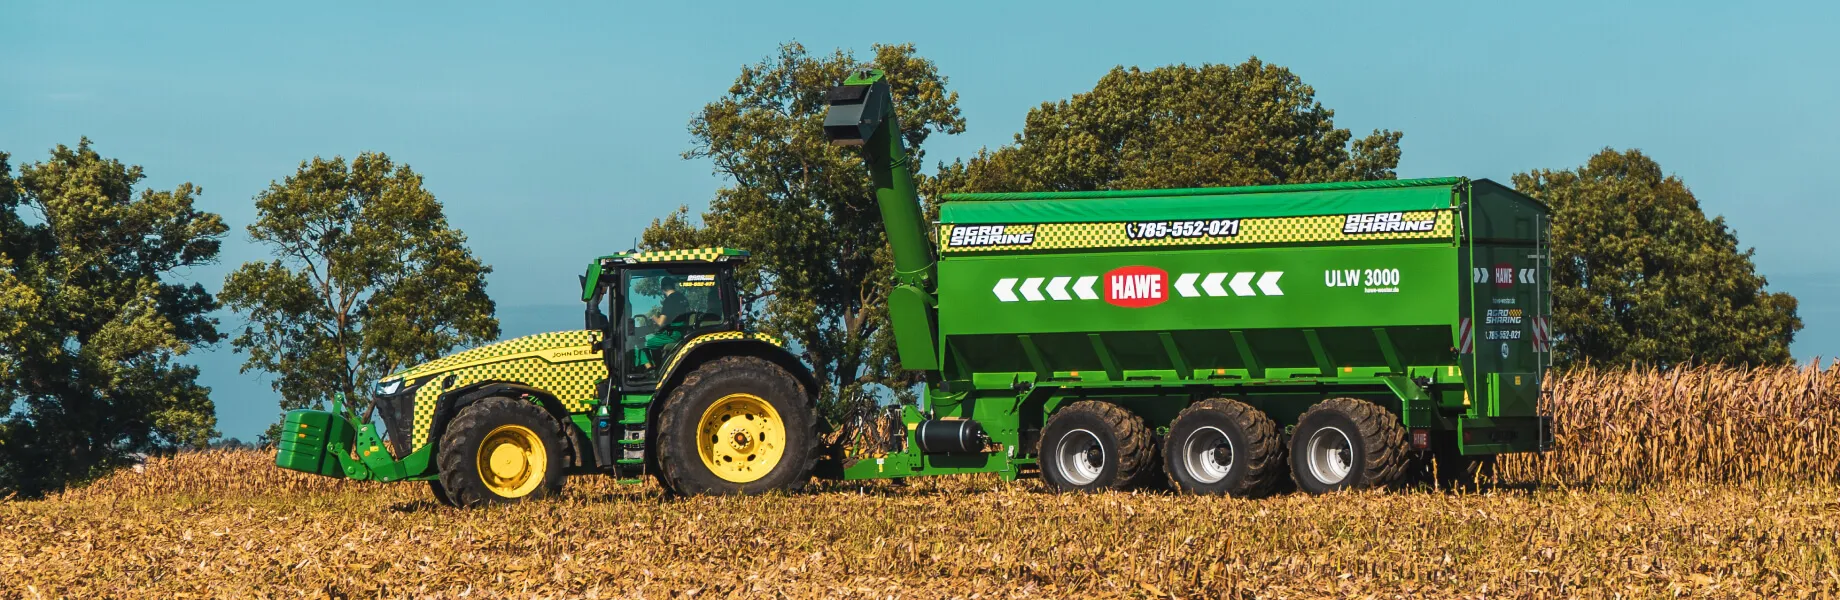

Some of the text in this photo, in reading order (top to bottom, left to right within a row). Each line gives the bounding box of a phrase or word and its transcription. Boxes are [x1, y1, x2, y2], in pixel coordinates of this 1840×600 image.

[1346, 212, 1403, 224] AGRO
[952, 225, 1005, 237] AGRO
[1137, 219, 1239, 238] 785-552-021
[1343, 220, 1434, 233] SHARING
[949, 233, 1034, 246] SHARING
[1325, 268, 1400, 287] ULW 3000
[1495, 267, 1512, 284] HAWE
[1111, 274, 1162, 300] HAWE
[1485, 316, 1522, 324] SHARING
